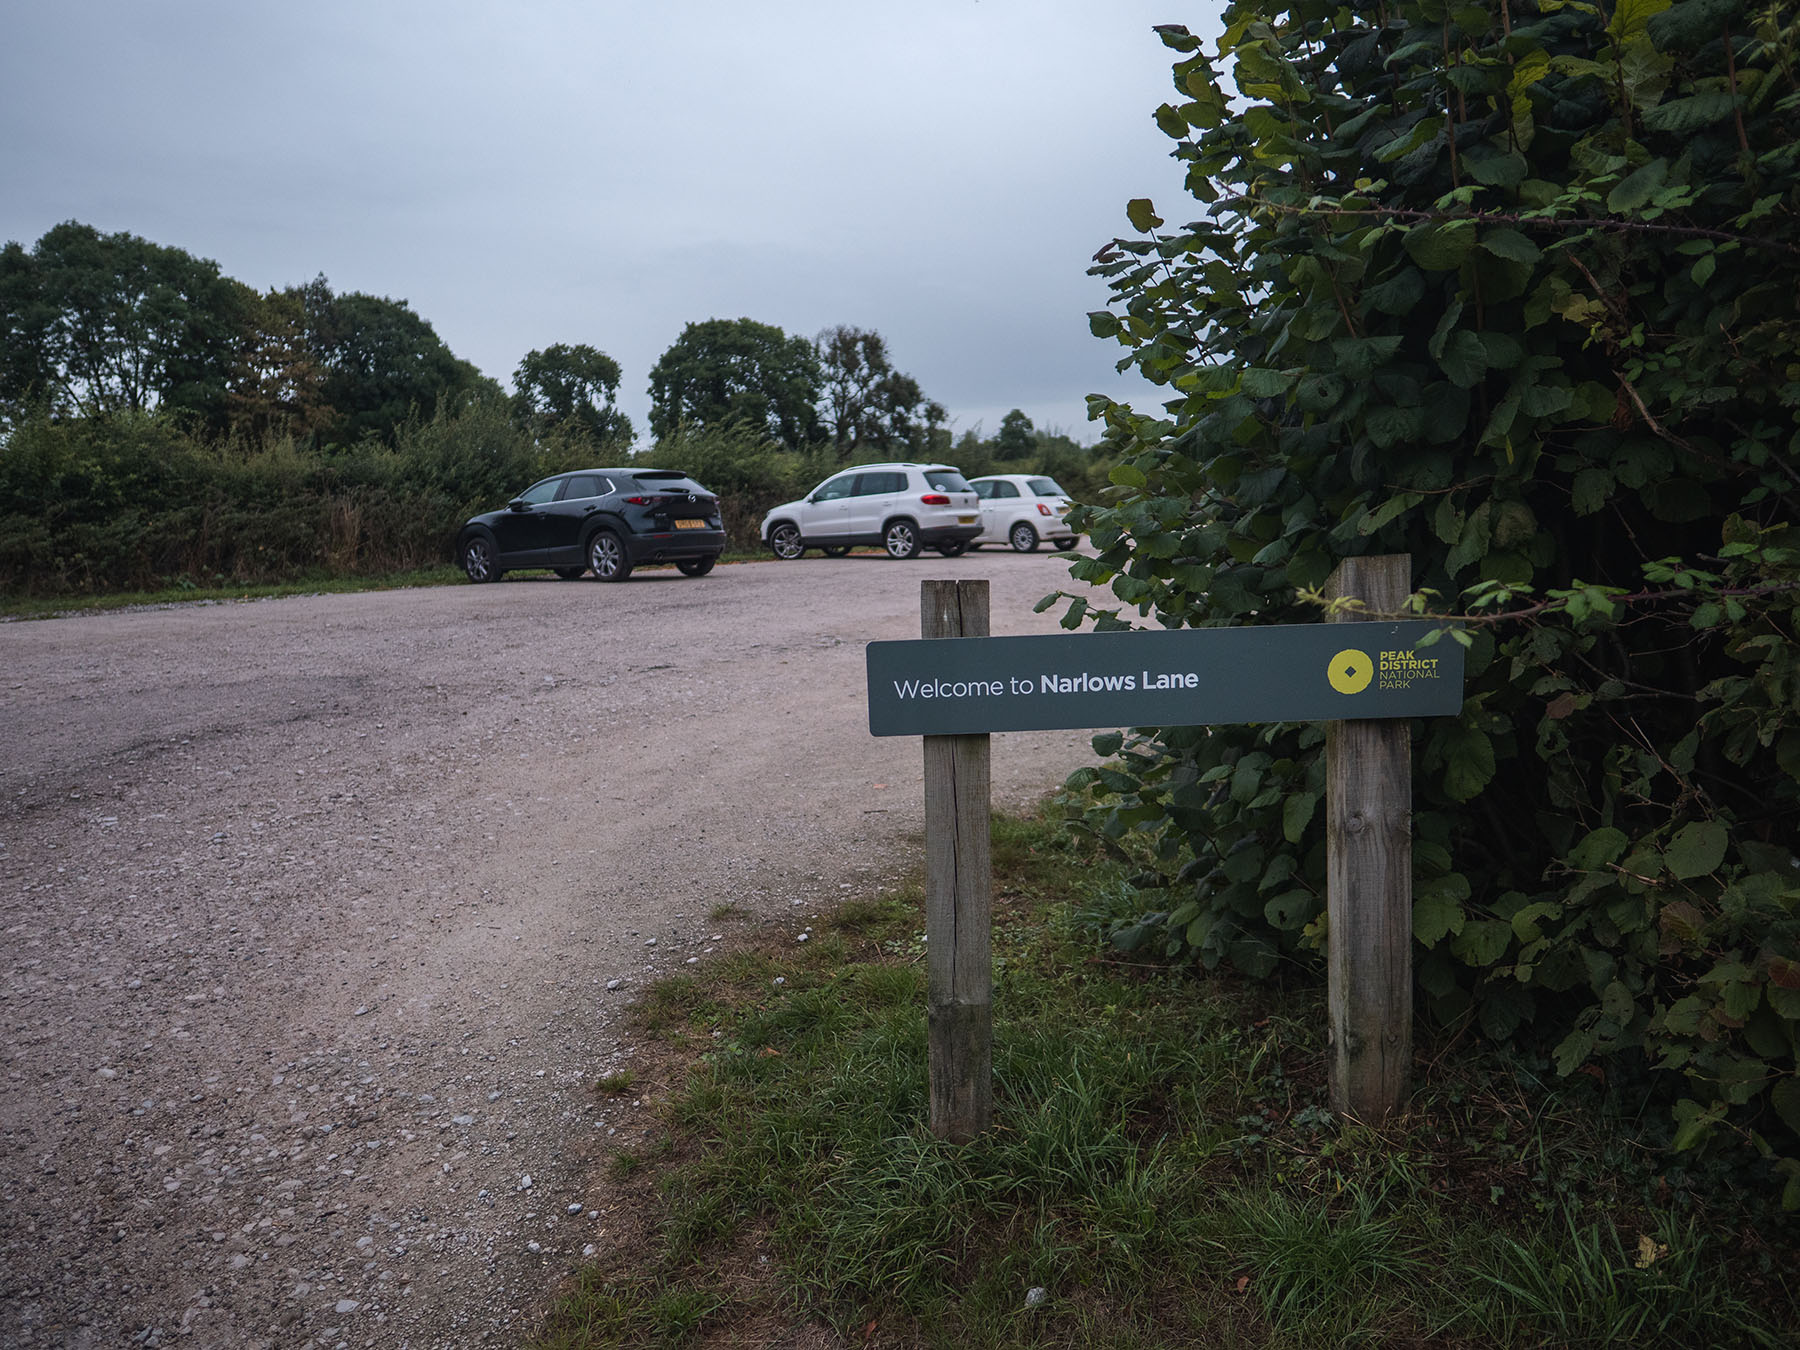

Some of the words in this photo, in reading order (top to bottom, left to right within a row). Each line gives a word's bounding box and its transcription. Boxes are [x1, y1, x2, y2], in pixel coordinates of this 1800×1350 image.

[1379, 650, 1415, 661] PEAK
[1379, 659, 1439, 671] DISTRICT
[1379, 669, 1440, 680] NATIONAL
[893, 678, 1004, 700] Welcome
[1009, 676, 1034, 696] to
[1040, 672, 1136, 694] Narlows
[1142, 670, 1200, 690] Lane
[1379, 679, 1411, 689] PARK
